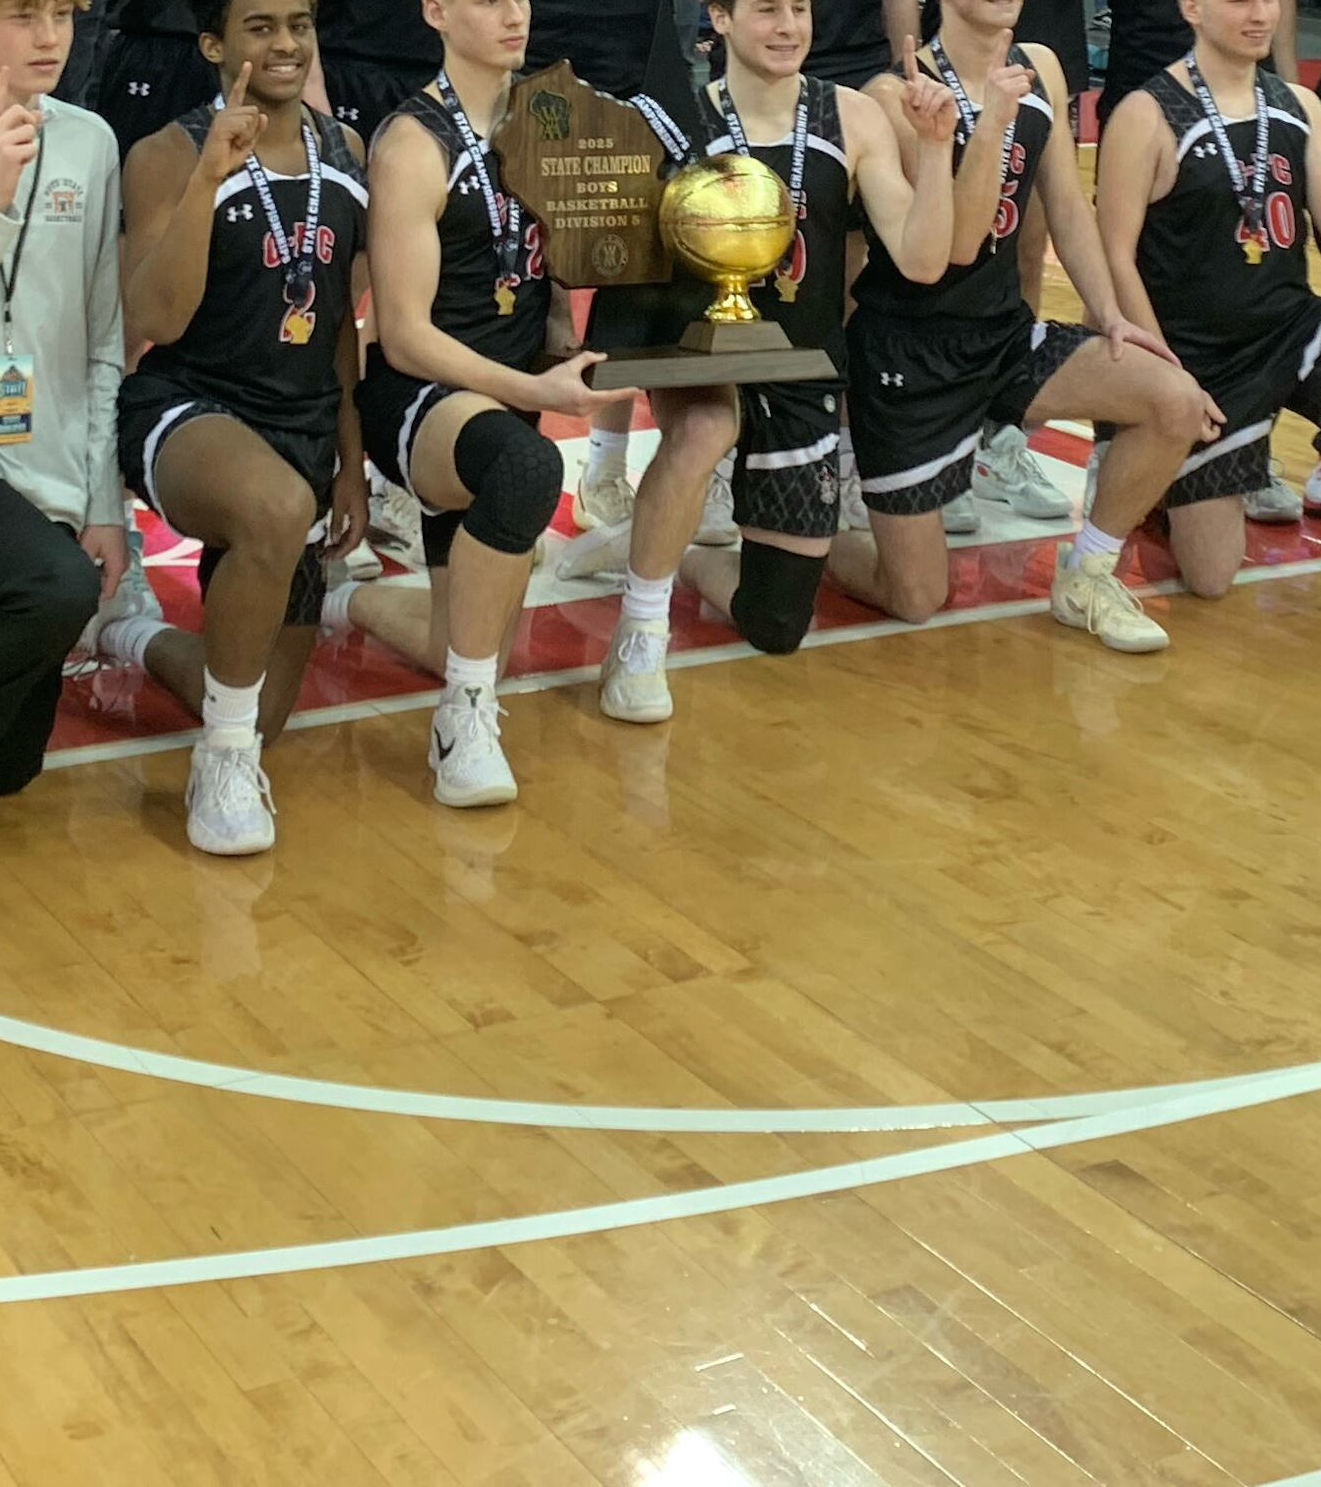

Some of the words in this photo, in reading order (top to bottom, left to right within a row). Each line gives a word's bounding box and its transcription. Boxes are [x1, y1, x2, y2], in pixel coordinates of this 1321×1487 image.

[577, 137, 614, 150] 2025
[726, 112, 749, 145] STATE
[790, 103, 808, 190] CHAMPIONSHIPS
[305, 124, 322, 214] CHAMPIONSHIPS
[452, 111, 476, 146] STATE
[470, 145, 503, 237] CHAMPIONSHIPS
[541, 155, 581, 177] STATE
[584, 154, 652, 175] CHAMPION
[576, 180, 619, 194] BOYS
[253, 169, 291, 265] CHAMPIONSHIPS
[545, 196, 649, 212] BASKETBALL
[301, 213, 319, 255] STATE
[555, 215, 627, 229] DIVISION
[631, 215, 641, 226] 5
